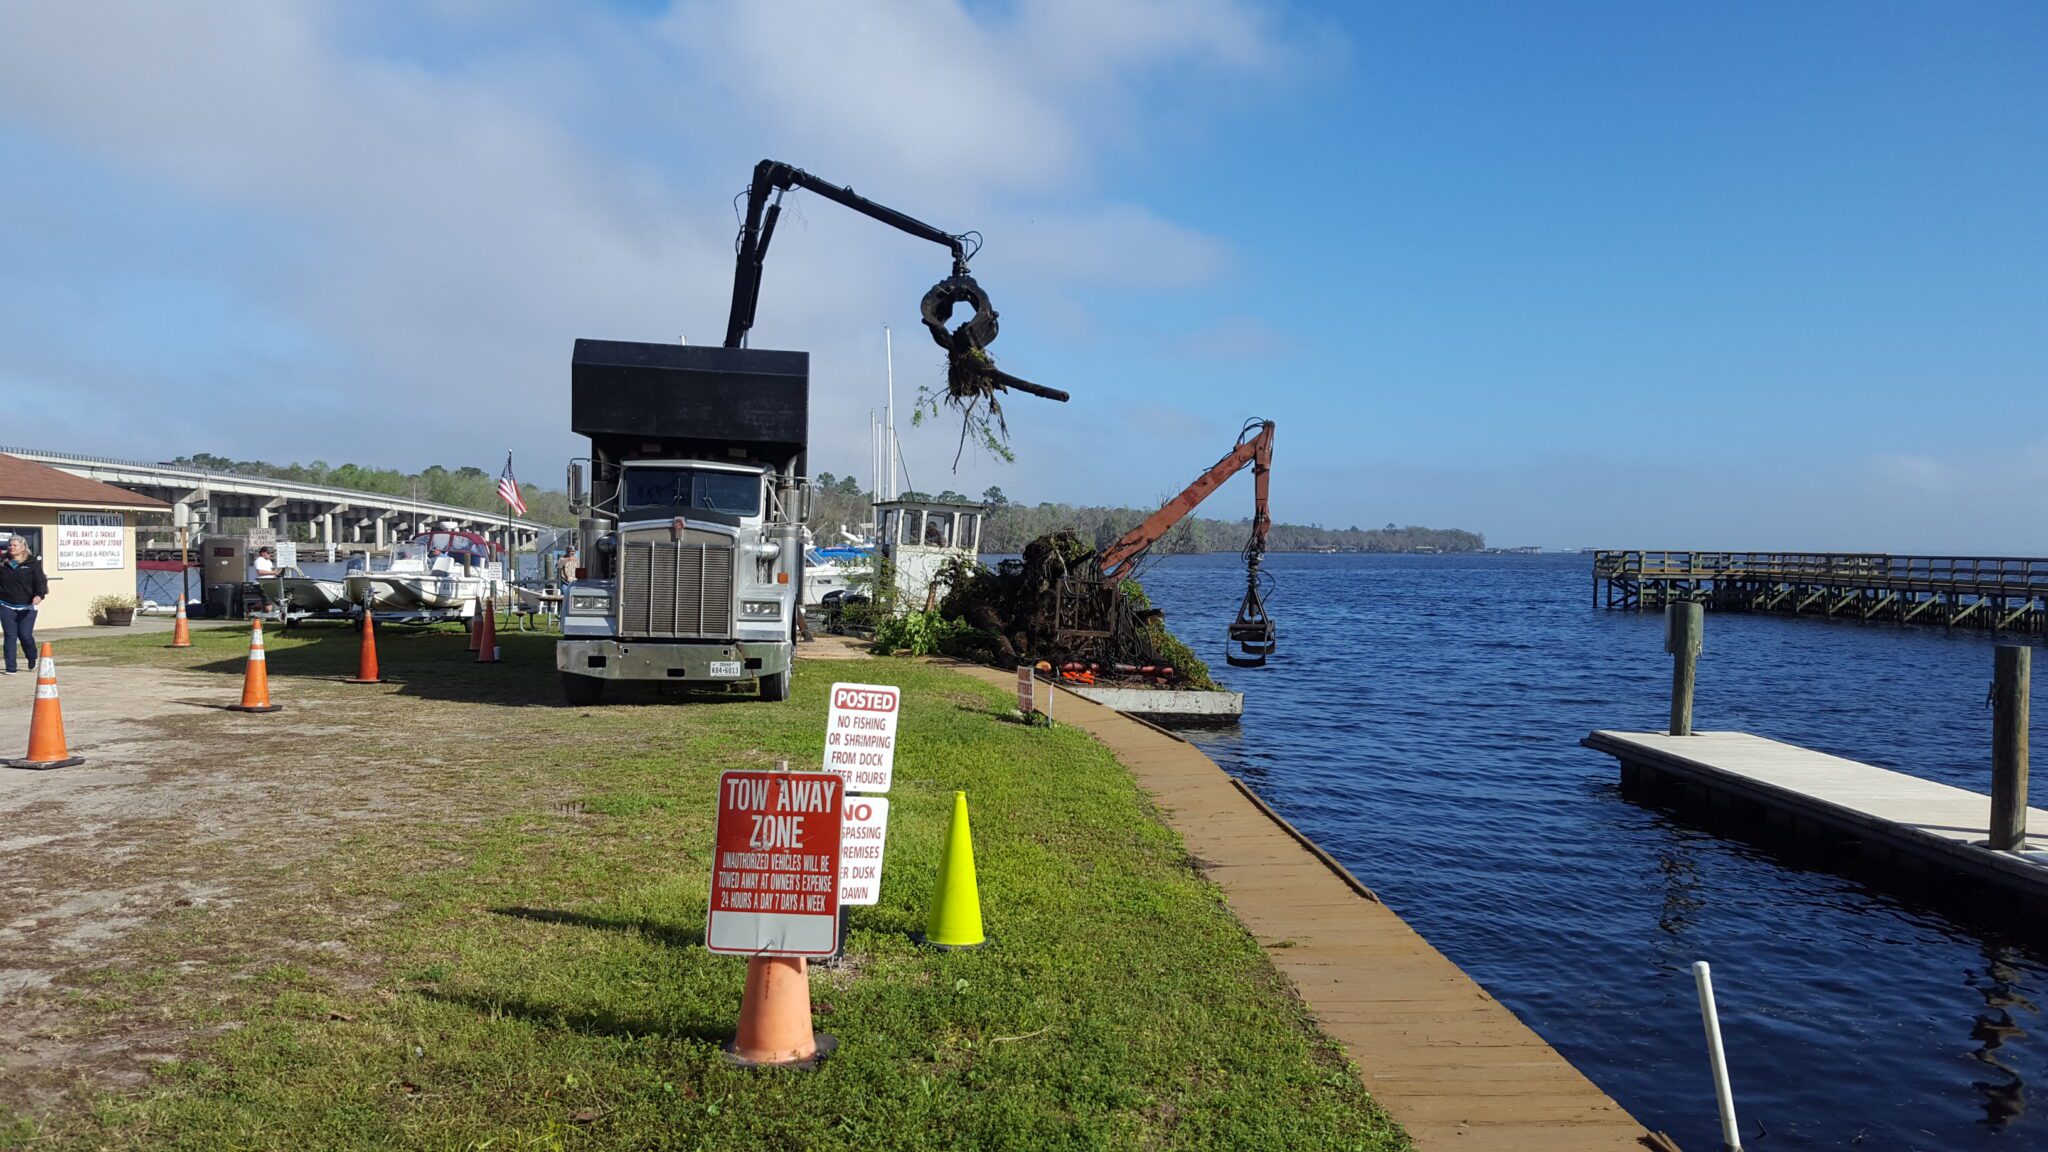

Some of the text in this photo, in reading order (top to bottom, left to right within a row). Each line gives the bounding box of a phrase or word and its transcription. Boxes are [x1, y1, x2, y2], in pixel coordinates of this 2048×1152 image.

[837, 690, 893, 710] POSTED
[838, 715, 886, 730] NO FISHING
[828, 732, 891, 748] OR SHRIMPING
[831, 751, 883, 766] FROM DOCK
[856, 771, 887, 784] HOURS!
[727, 778, 835, 813] TOW AWAY
[844, 804, 872, 821] NO
[749, 815, 804, 850] ZONE
[841, 846, 879, 859] REMISES
[723, 852, 830, 872] UNAUTHORIZED VEHICLES WILL BE
[852, 866, 875, 879] DUSK
[719, 871, 832, 892] TOWED AWAY AT OWNER'S EXPENSE
[842, 887, 868, 899] DAWN
[721, 891, 825, 912] 24 HOURS A DAY 7 DAYS A WEEK
